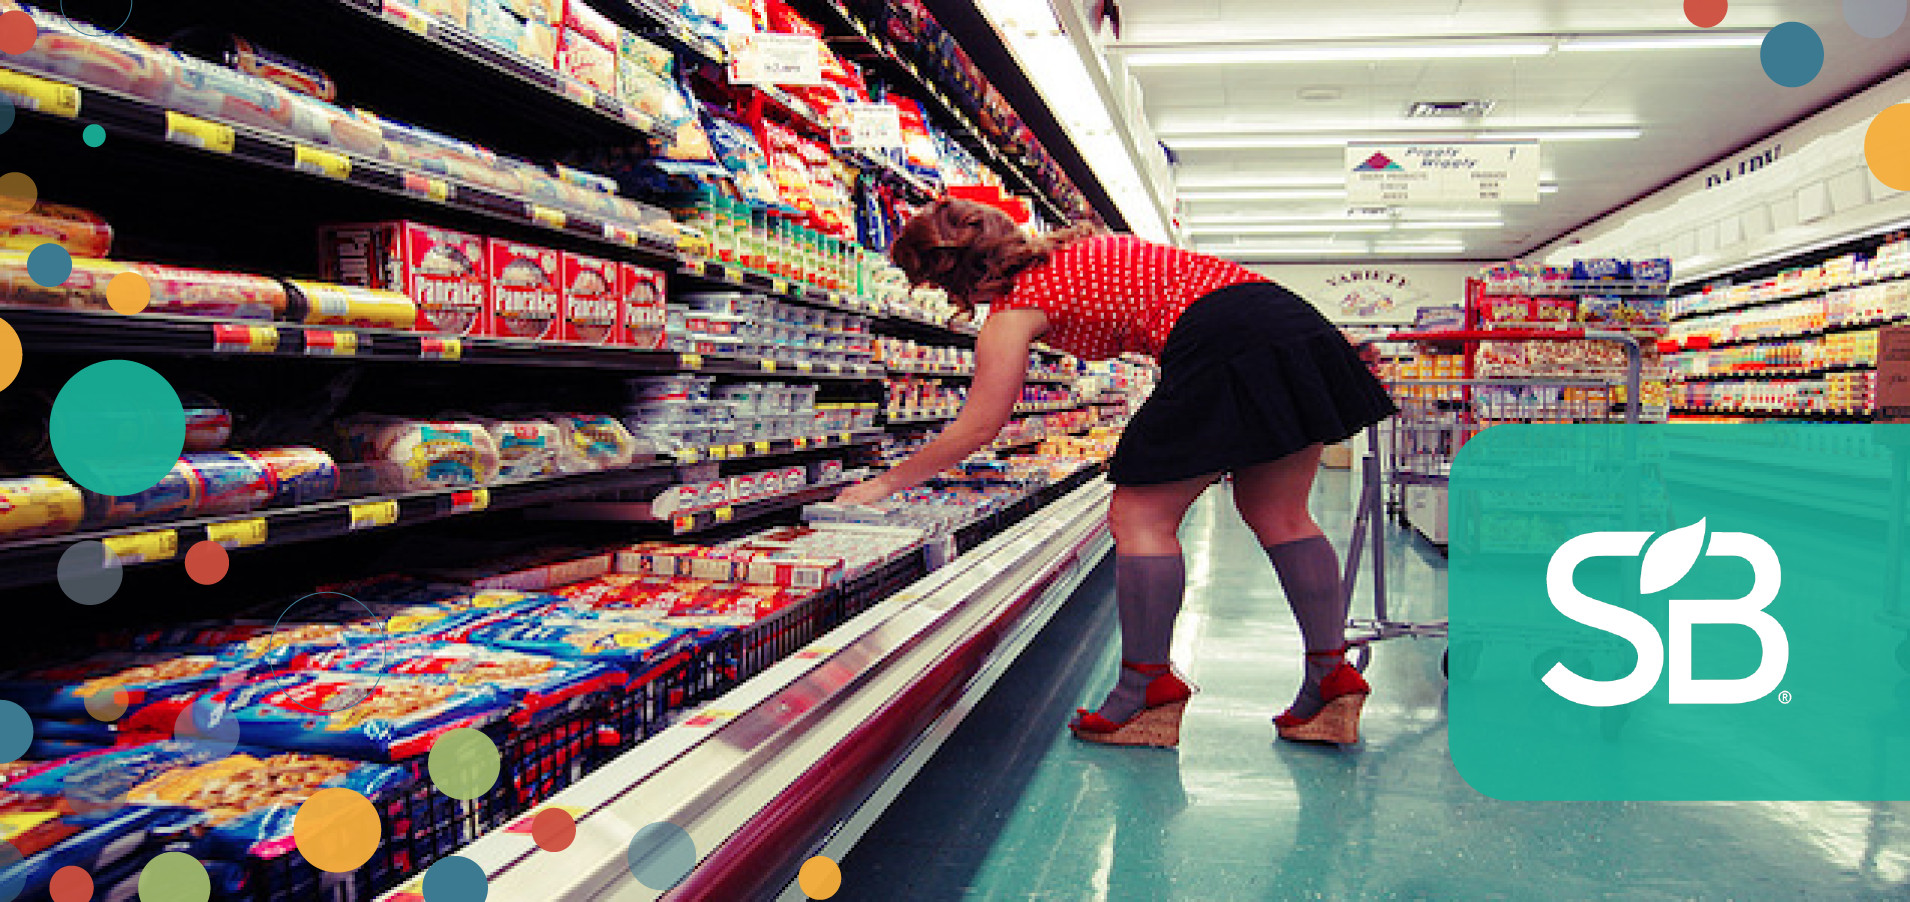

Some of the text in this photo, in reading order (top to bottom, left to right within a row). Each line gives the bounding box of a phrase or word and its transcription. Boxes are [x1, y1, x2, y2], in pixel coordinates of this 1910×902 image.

[416, 276, 482, 306] Pancakes
[1326, 270, 1407, 287] VARIETY
[496, 285, 557, 314] Pancakes
[568, 294, 616, 321] Pancakes
